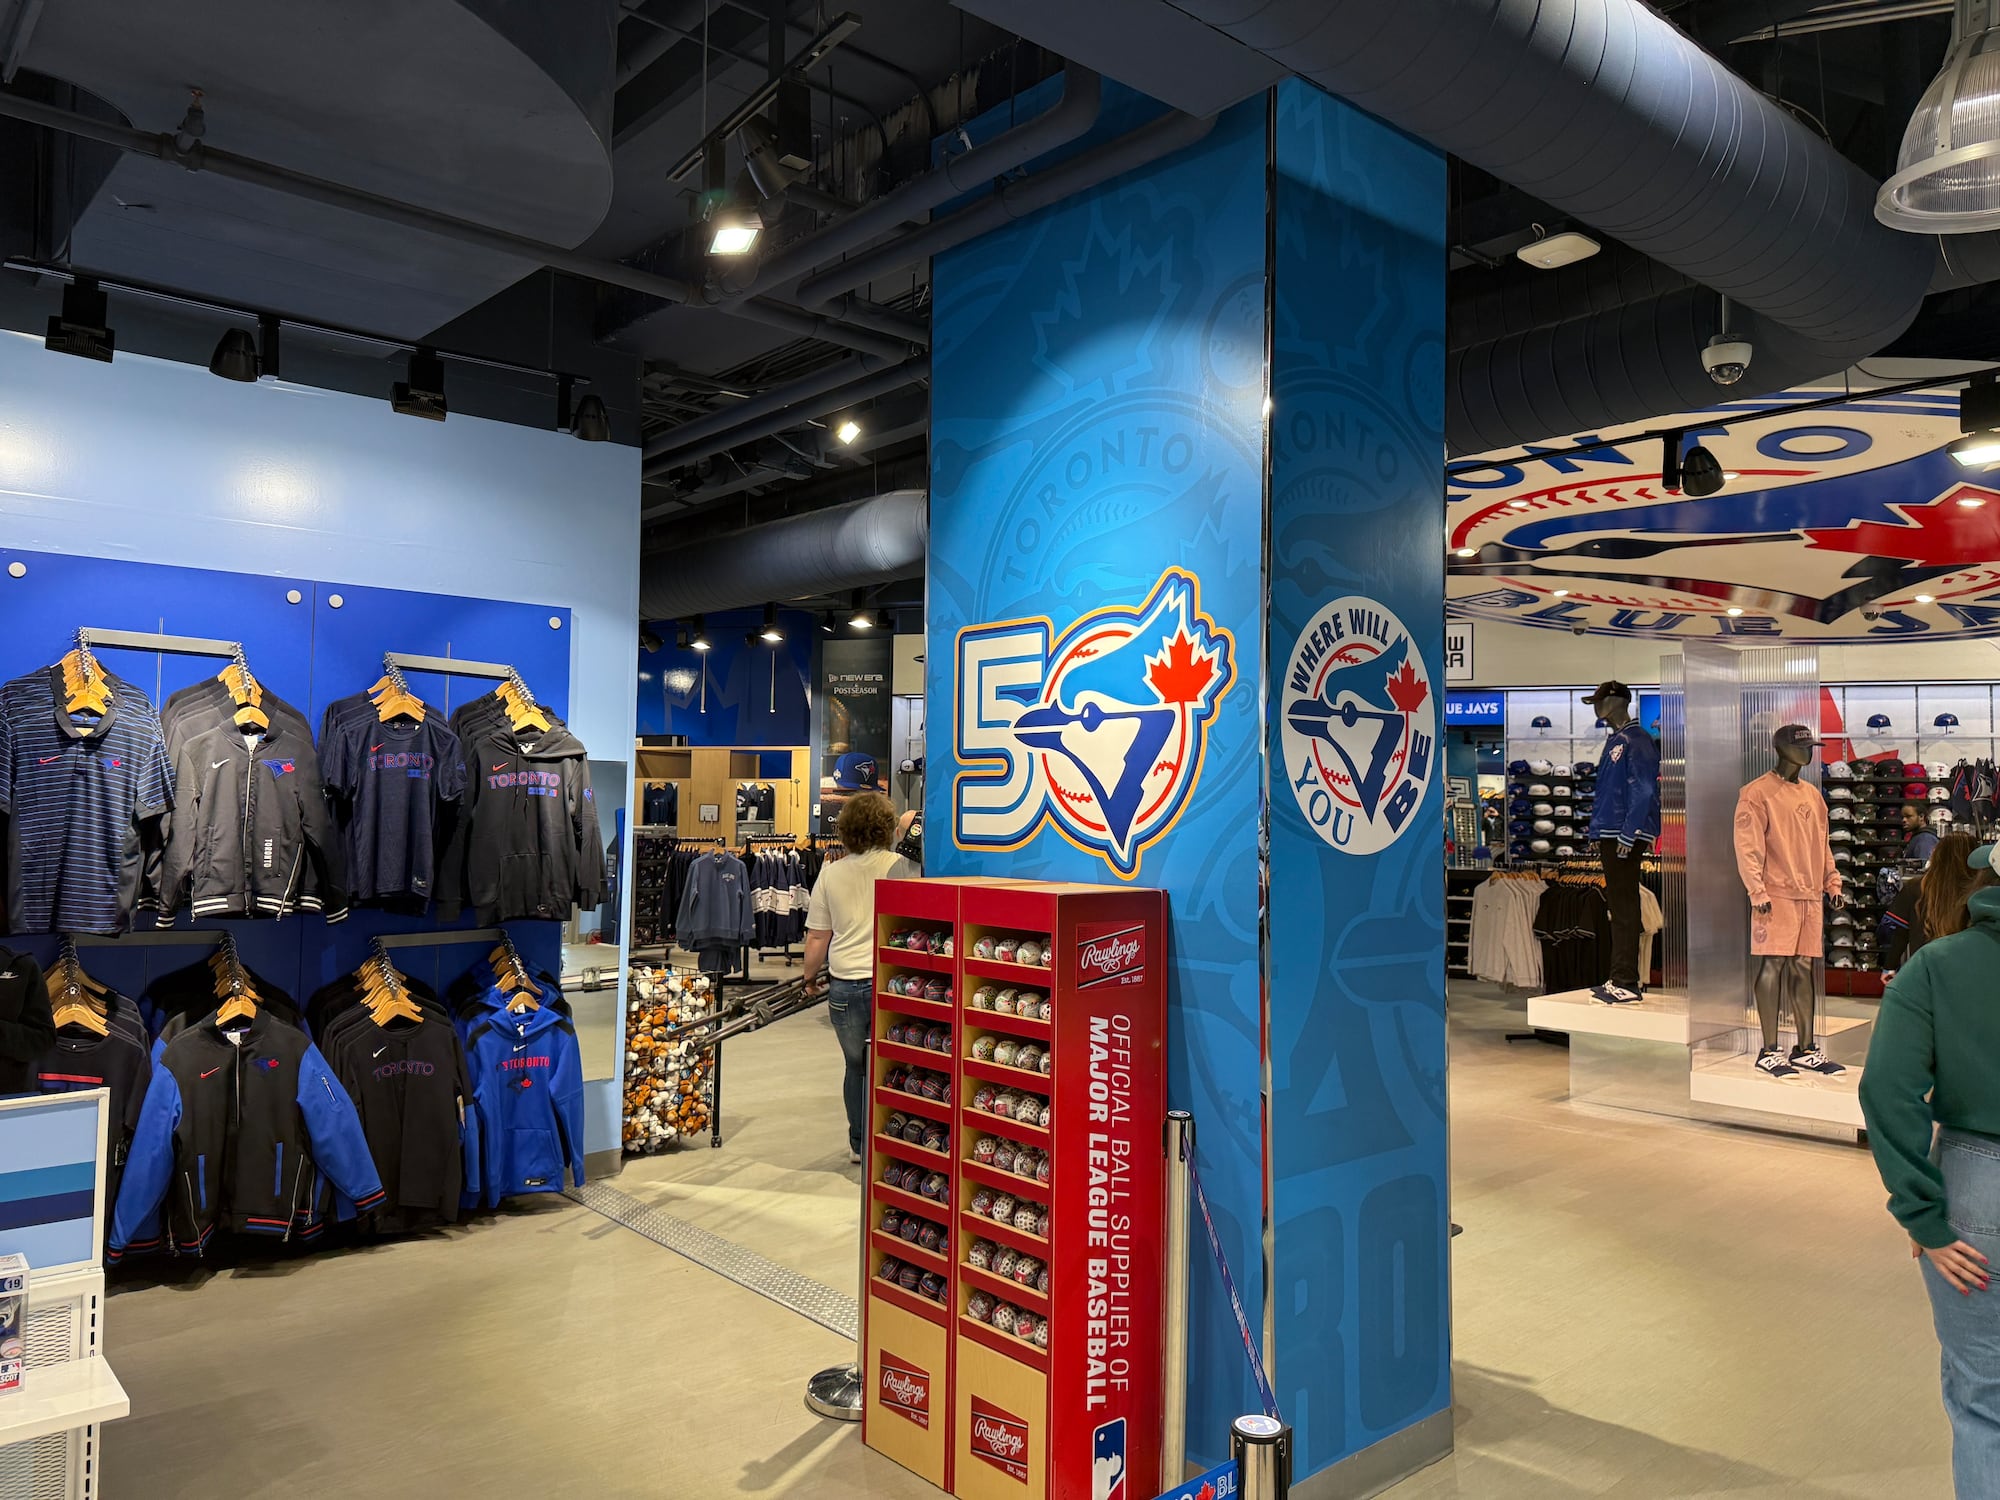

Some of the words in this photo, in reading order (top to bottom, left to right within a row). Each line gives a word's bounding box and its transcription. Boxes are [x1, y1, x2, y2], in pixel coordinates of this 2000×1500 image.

[1001, 425, 1195, 585] TORONTO
[1290, 612, 1345, 694] WHERE
[1348, 608, 1390, 647] WILL
[833, 686, 878, 695] POSTSEASON
[1464, 702, 1499, 715] JAYS
[487, 771, 561, 790] TORONTO
[1294, 756, 1355, 846] YOU
[1382, 729, 1432, 834] BE
[263, 838, 273, 868] TORONTO
[1081, 937, 1141, 970] Rawlings
[1088, 1015, 1109, 1123] MAJOR
[1111, 1014, 1131, 1129] OFFICIAL
[1087, 1132, 1109, 1248] LEAGUE
[1110, 1139, 1131, 1204] BALL
[7, 1279, 21, 1290] 19
[1109, 1213, 1131, 1348] SUPPLIER
[1086, 1258, 1108, 1412] BASEBALL
[882, 1370, 927, 1405] Rawlings
[1109, 1358, 1130, 1392] OF
[974, 1417, 1025, 1456] Rawlings
